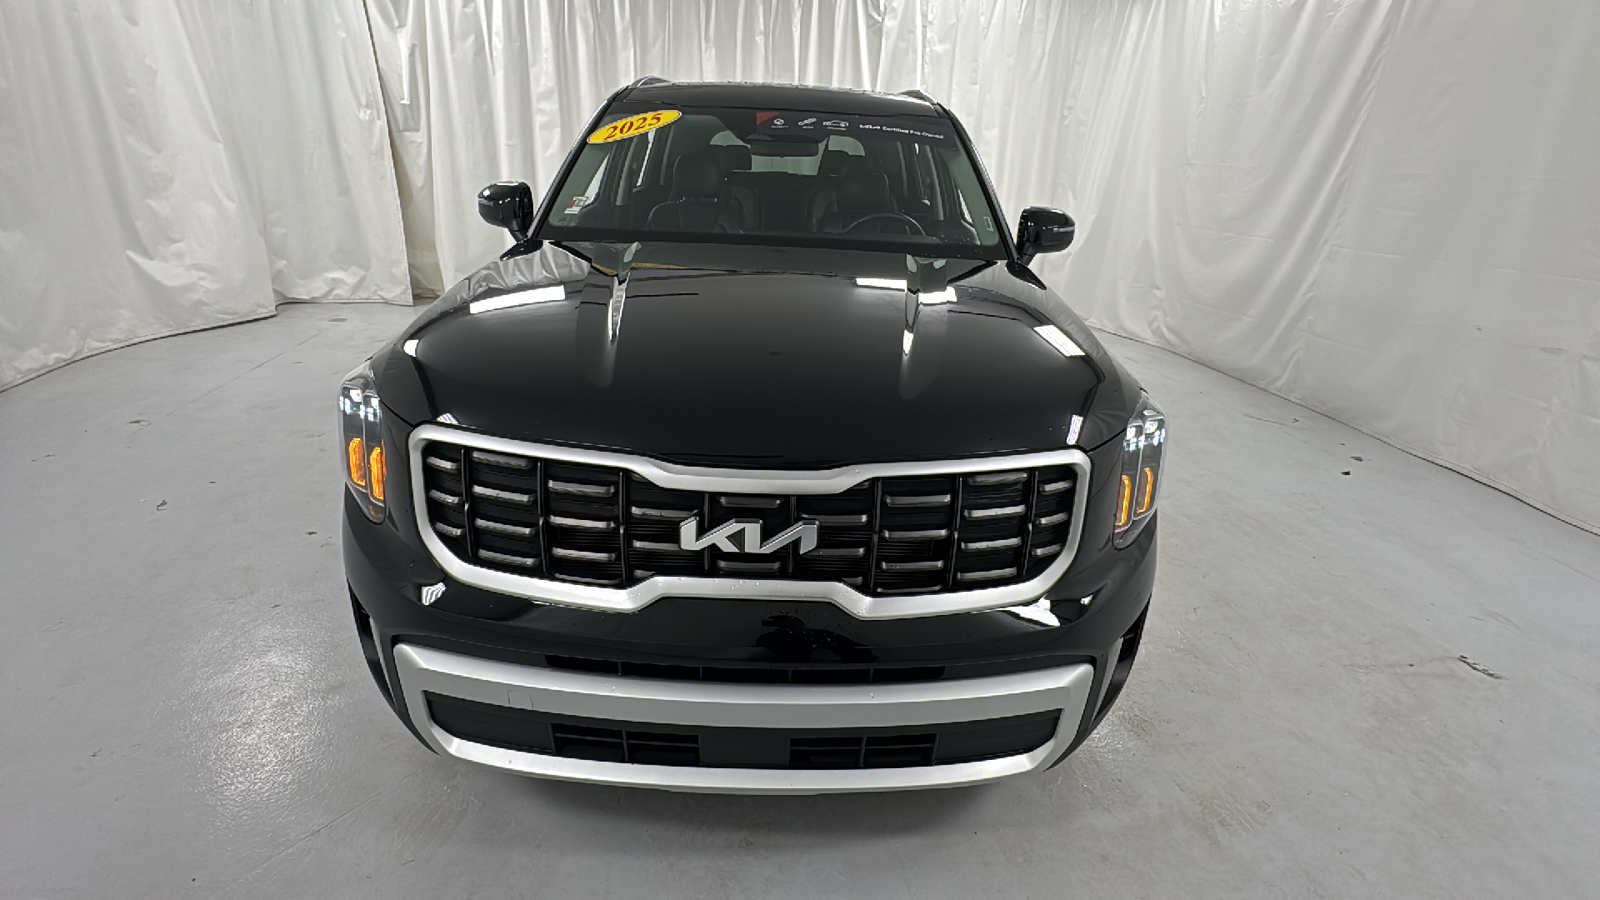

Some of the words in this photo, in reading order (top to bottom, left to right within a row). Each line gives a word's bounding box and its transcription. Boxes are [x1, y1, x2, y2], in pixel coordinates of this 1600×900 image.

[603, 112, 664, 141] 2025
[882, 126, 909, 134] Certified
[678, 515, 820, 555] KIA
